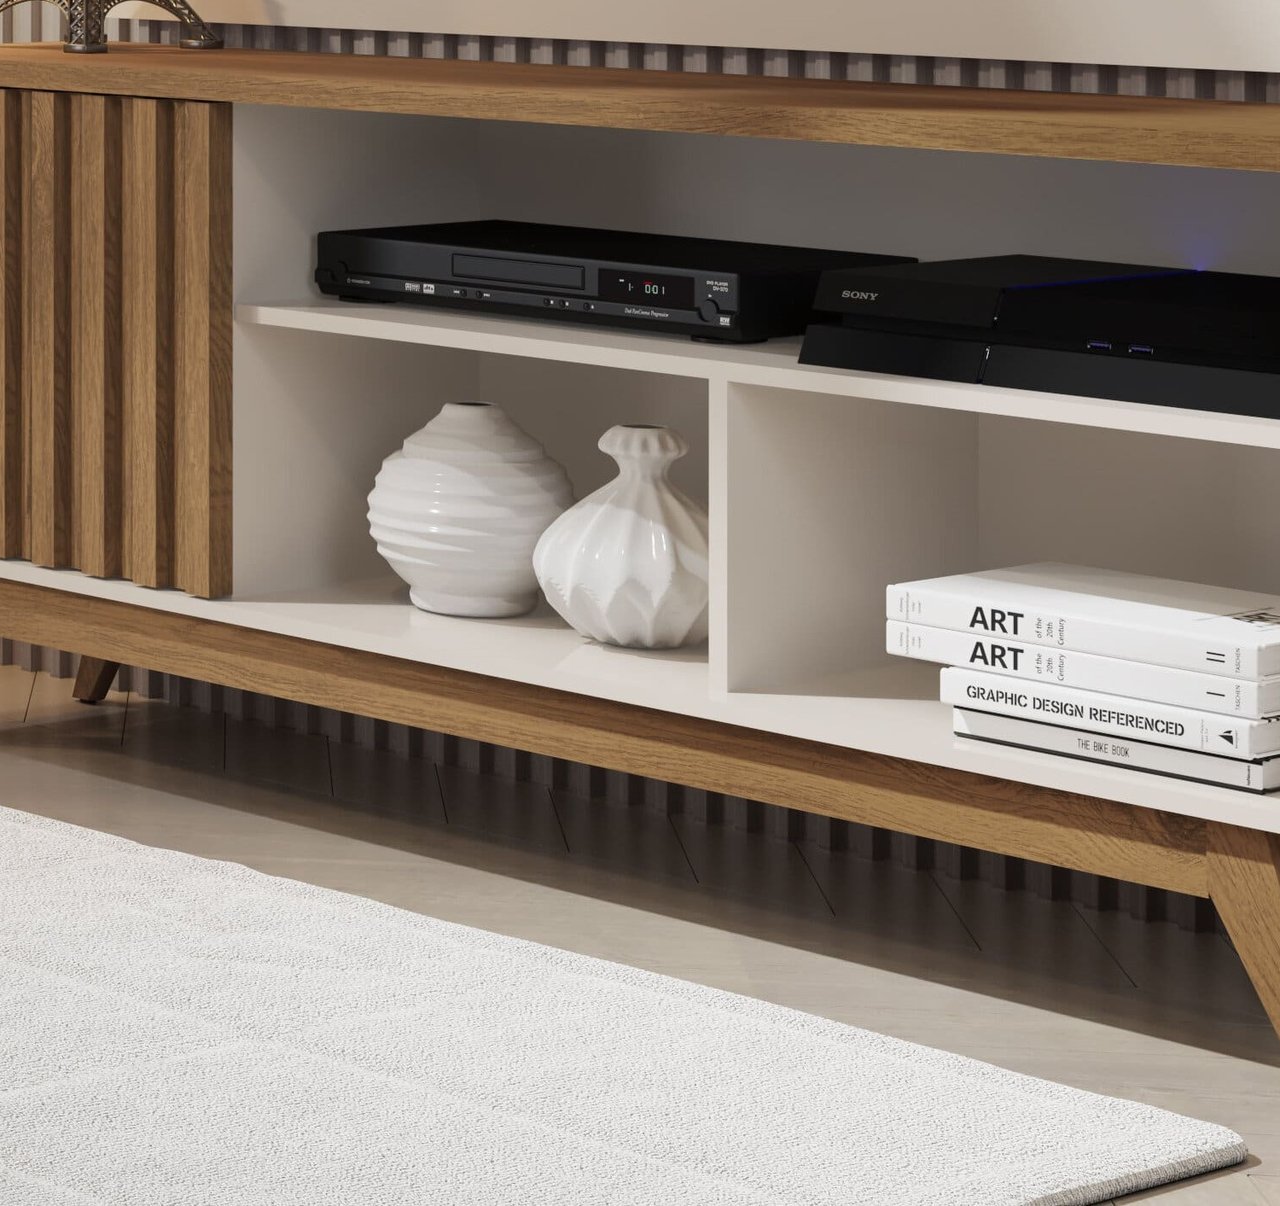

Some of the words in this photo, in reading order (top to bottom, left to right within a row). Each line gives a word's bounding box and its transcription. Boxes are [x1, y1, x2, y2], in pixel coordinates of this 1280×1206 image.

[841, 290, 879, 301] SONY
[969, 606, 1024, 635] ART
[1057, 618, 1066, 646] Century
[969, 641, 1024, 671] ART
[1057, 654, 1066, 681] Century
[966, 685, 1028, 708] GRAPHIC
[1032, 697, 1084, 719] DESIGN
[1089, 707, 1185, 737] REFERENCED
[1077, 738, 1091, 751] THE
[1093, 741, 1109, 754] BIKE
[1111, 745, 1130, 758] BOOK
